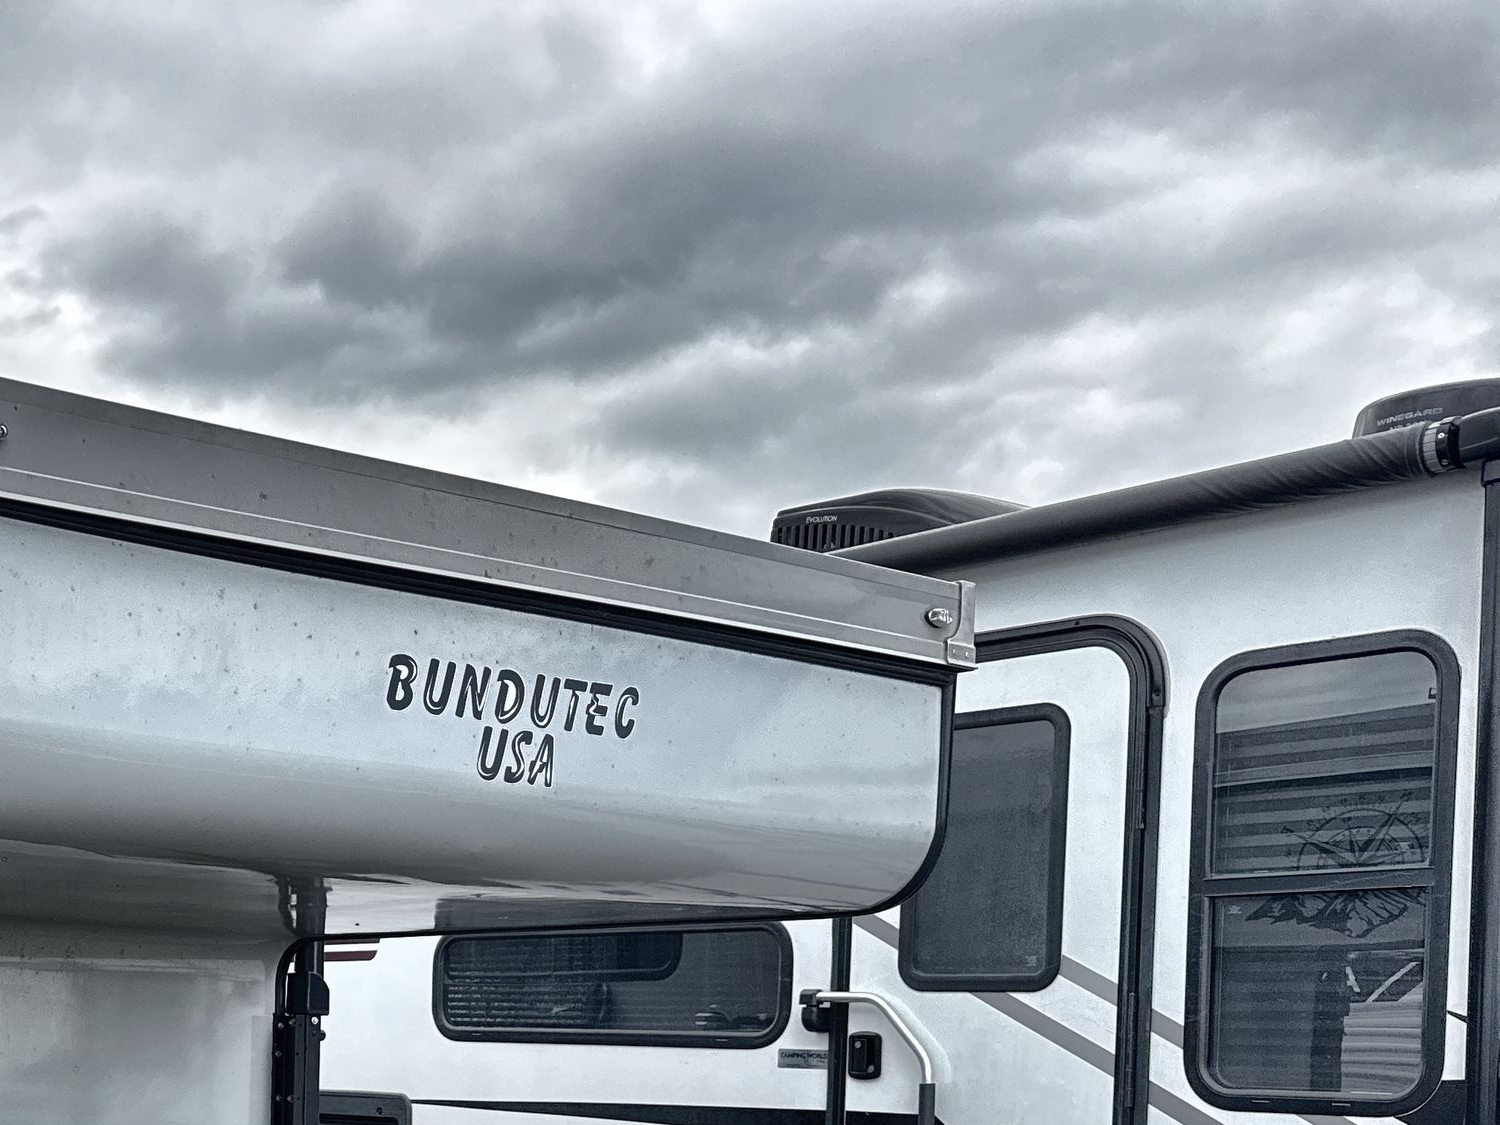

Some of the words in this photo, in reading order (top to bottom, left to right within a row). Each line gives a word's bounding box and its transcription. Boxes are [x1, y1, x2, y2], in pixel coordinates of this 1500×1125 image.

[1377, 408, 1443, 425] WINEGARD
[386, 653, 640, 739] BUNDUTEC
[476, 725, 555, 788] USA
